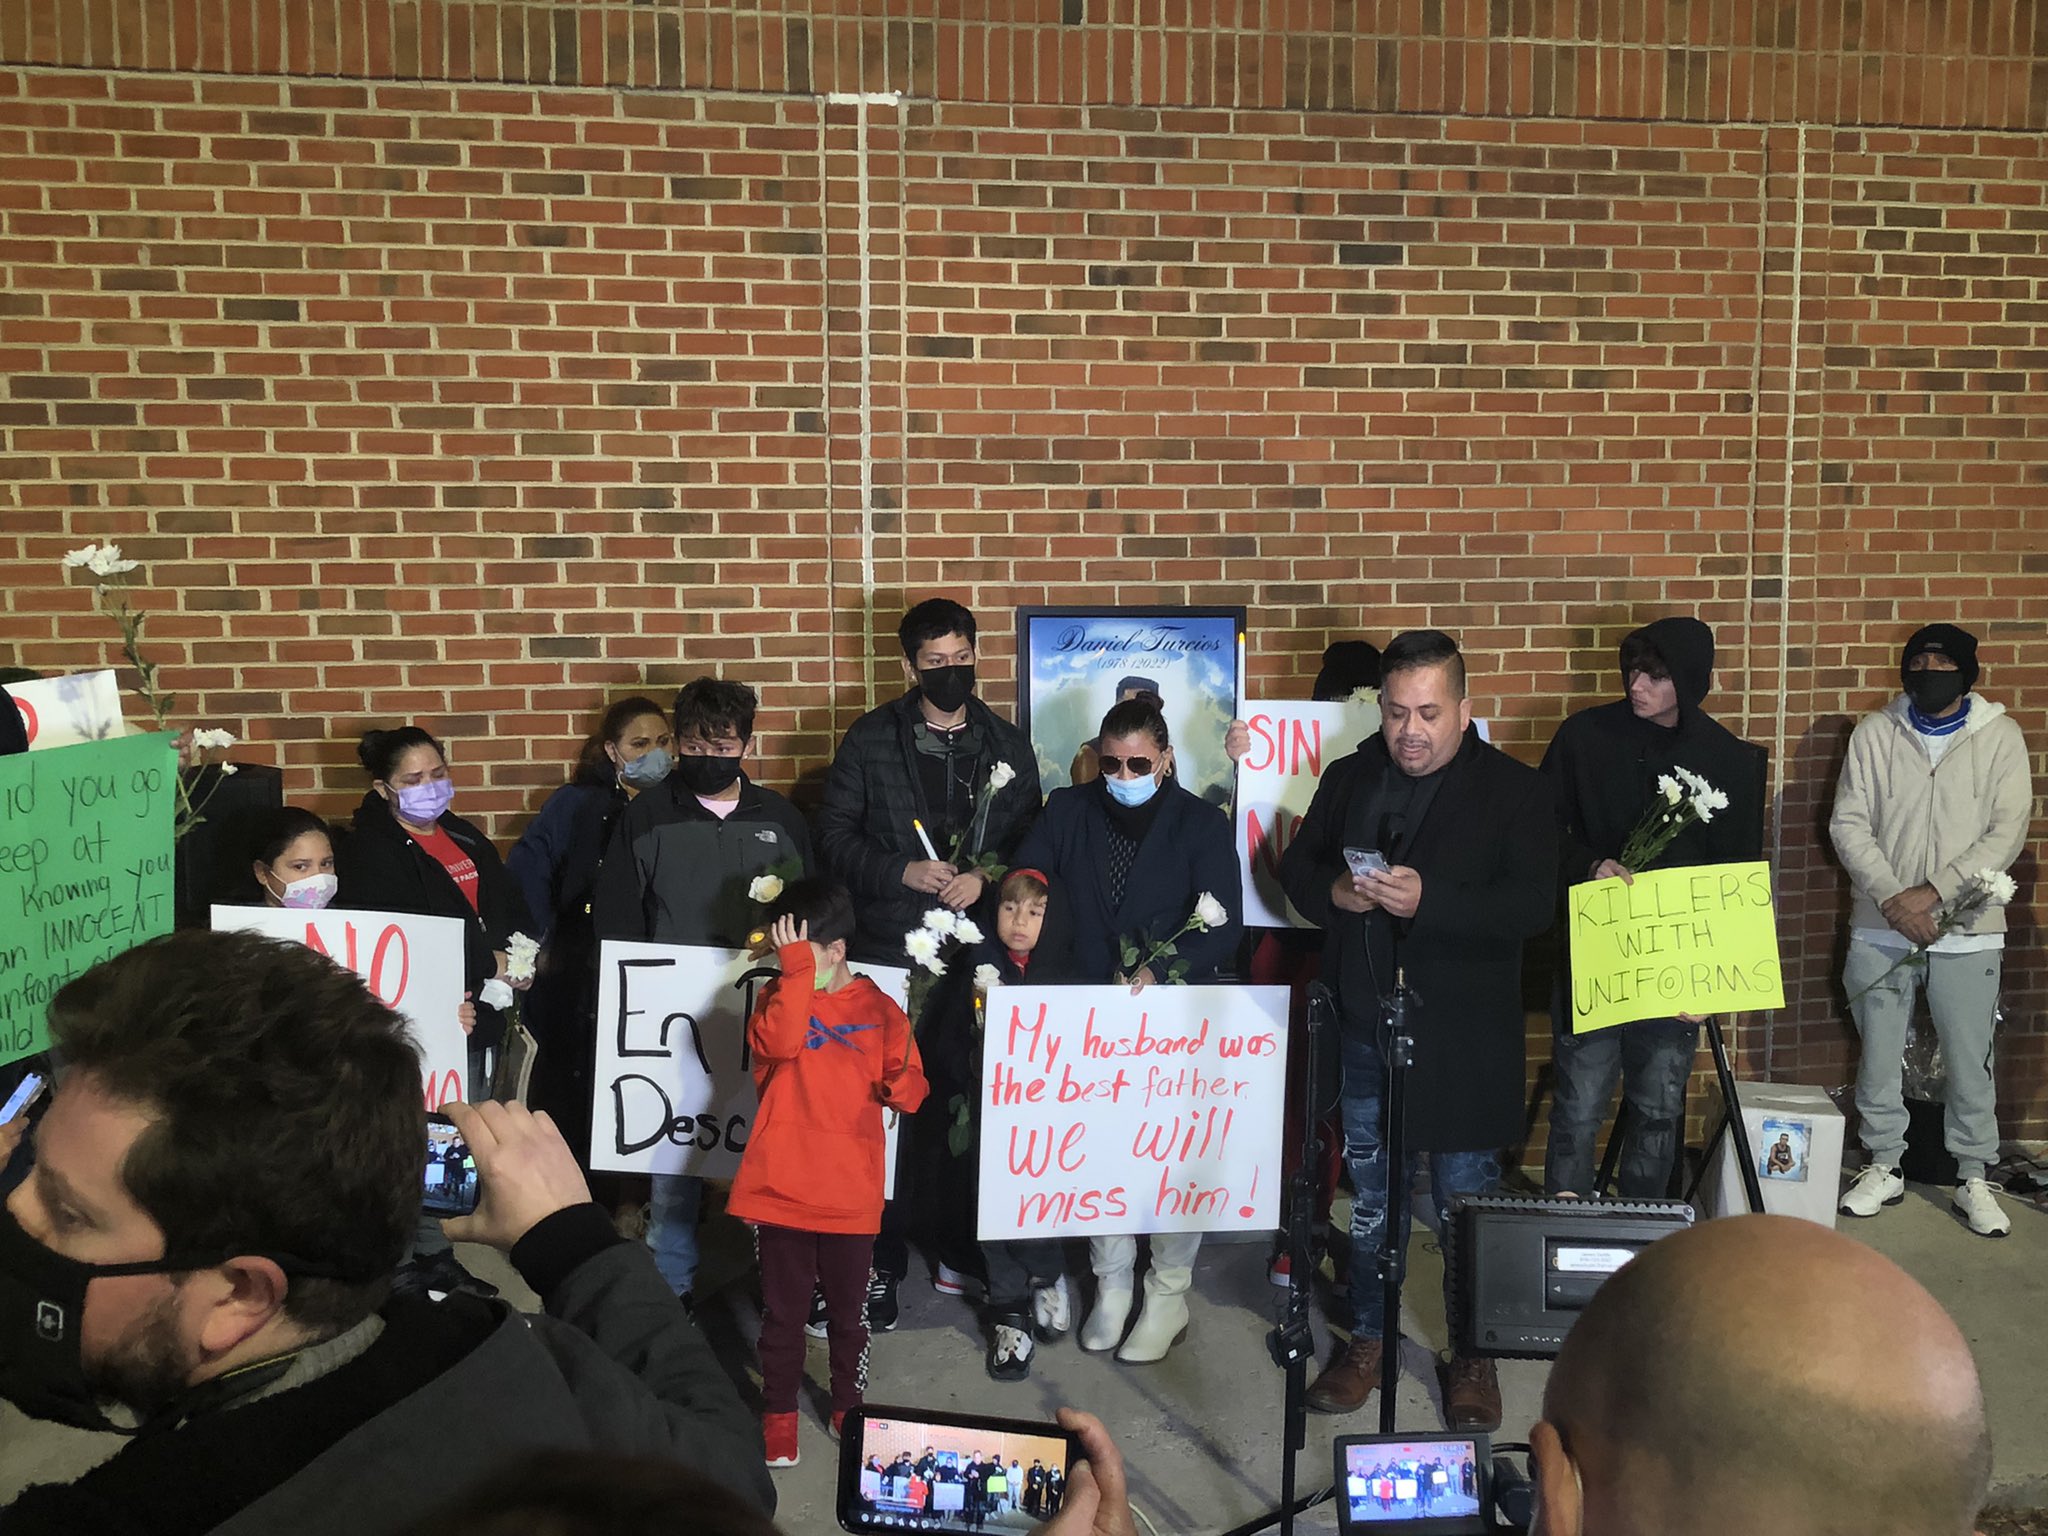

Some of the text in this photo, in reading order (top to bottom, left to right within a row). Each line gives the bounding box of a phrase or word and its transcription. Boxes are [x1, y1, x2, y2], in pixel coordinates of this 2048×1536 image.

[1051, 624, 1221, 651] Daniel Turcios
[1244, 714, 1321, 777] SIN
[62, 775, 117, 827] you
[132, 768, 161, 818] go
[74, 821, 110, 863] at
[126, 853, 170, 900] you
[1576, 871, 1772, 936] KILLERS
[45, 893, 165, 960] INNOCENT
[1615, 919, 1713, 958] WITH
[1575, 959, 1775, 1016] UNIFORMS
[0, 1012, 33, 1052] ild
[617, 959, 712, 1074] En
[1008, 1003, 1277, 1073] My husband was
[989, 1062, 1046, 1106] the
[1056, 1064, 1130, 1103] best
[1132, 1106, 1233, 1162] will
[1017, 1186, 1127, 1228] miss
